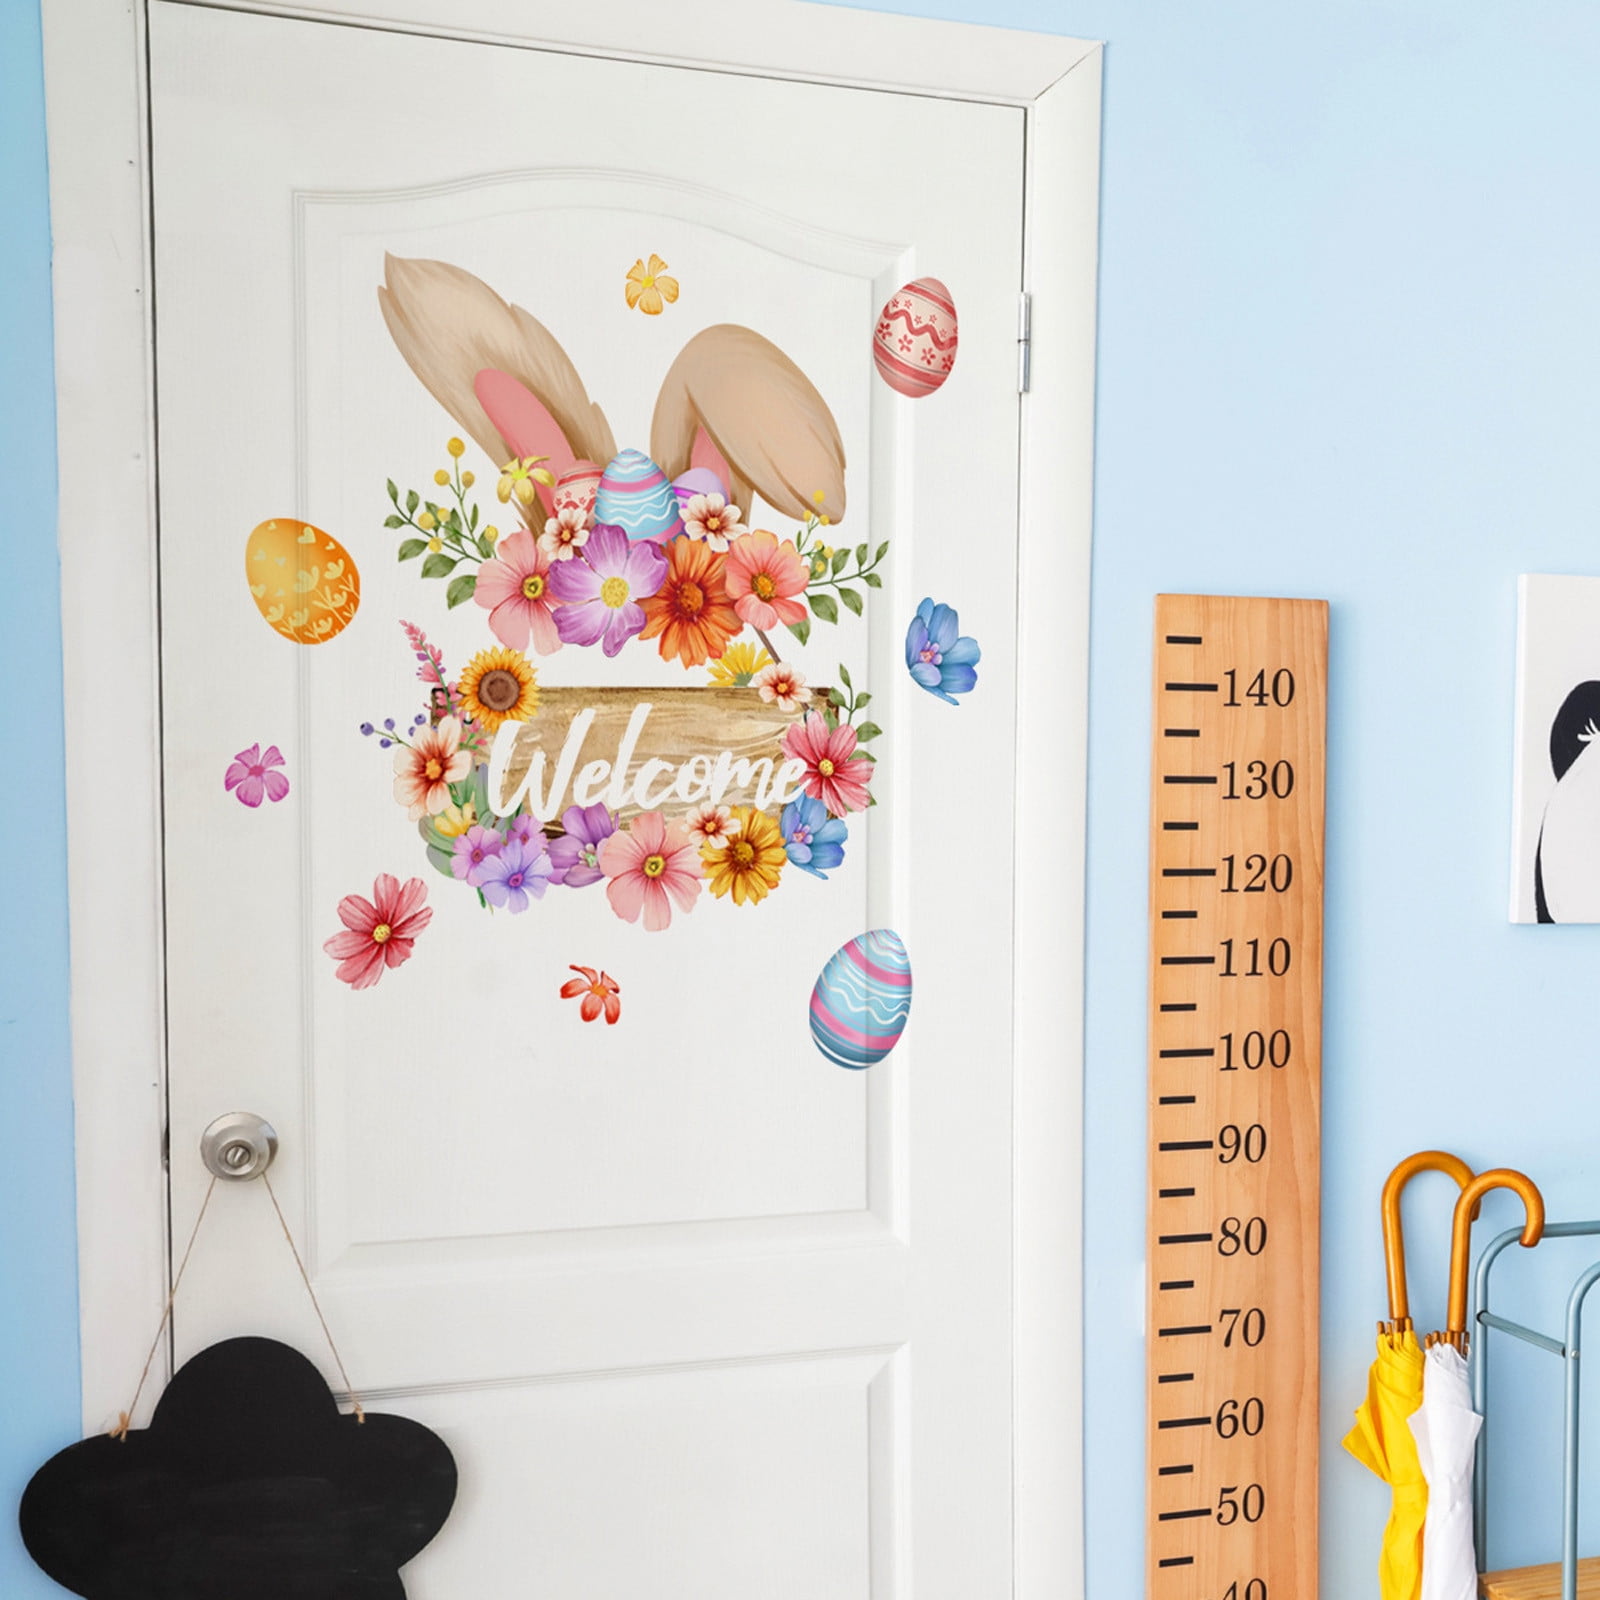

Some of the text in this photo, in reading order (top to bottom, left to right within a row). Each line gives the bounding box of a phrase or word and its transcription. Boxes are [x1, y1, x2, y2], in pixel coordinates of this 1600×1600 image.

[1222, 668, 1295, 707] 140
[487, 702, 812, 822] Welcome
[1221, 759, 1294, 800] 130
[1220, 853, 1293, 893] 120
[1218, 937, 1291, 977] 110
[1218, 1029, 1291, 1071] 100
[1218, 1124, 1267, 1164] 90
[1217, 1216, 1267, 1257] 80
[1218, 1307, 1266, 1348] 70
[1215, 1397, 1265, 1439] 60
[1216, 1483, 1265, 1526] 50
